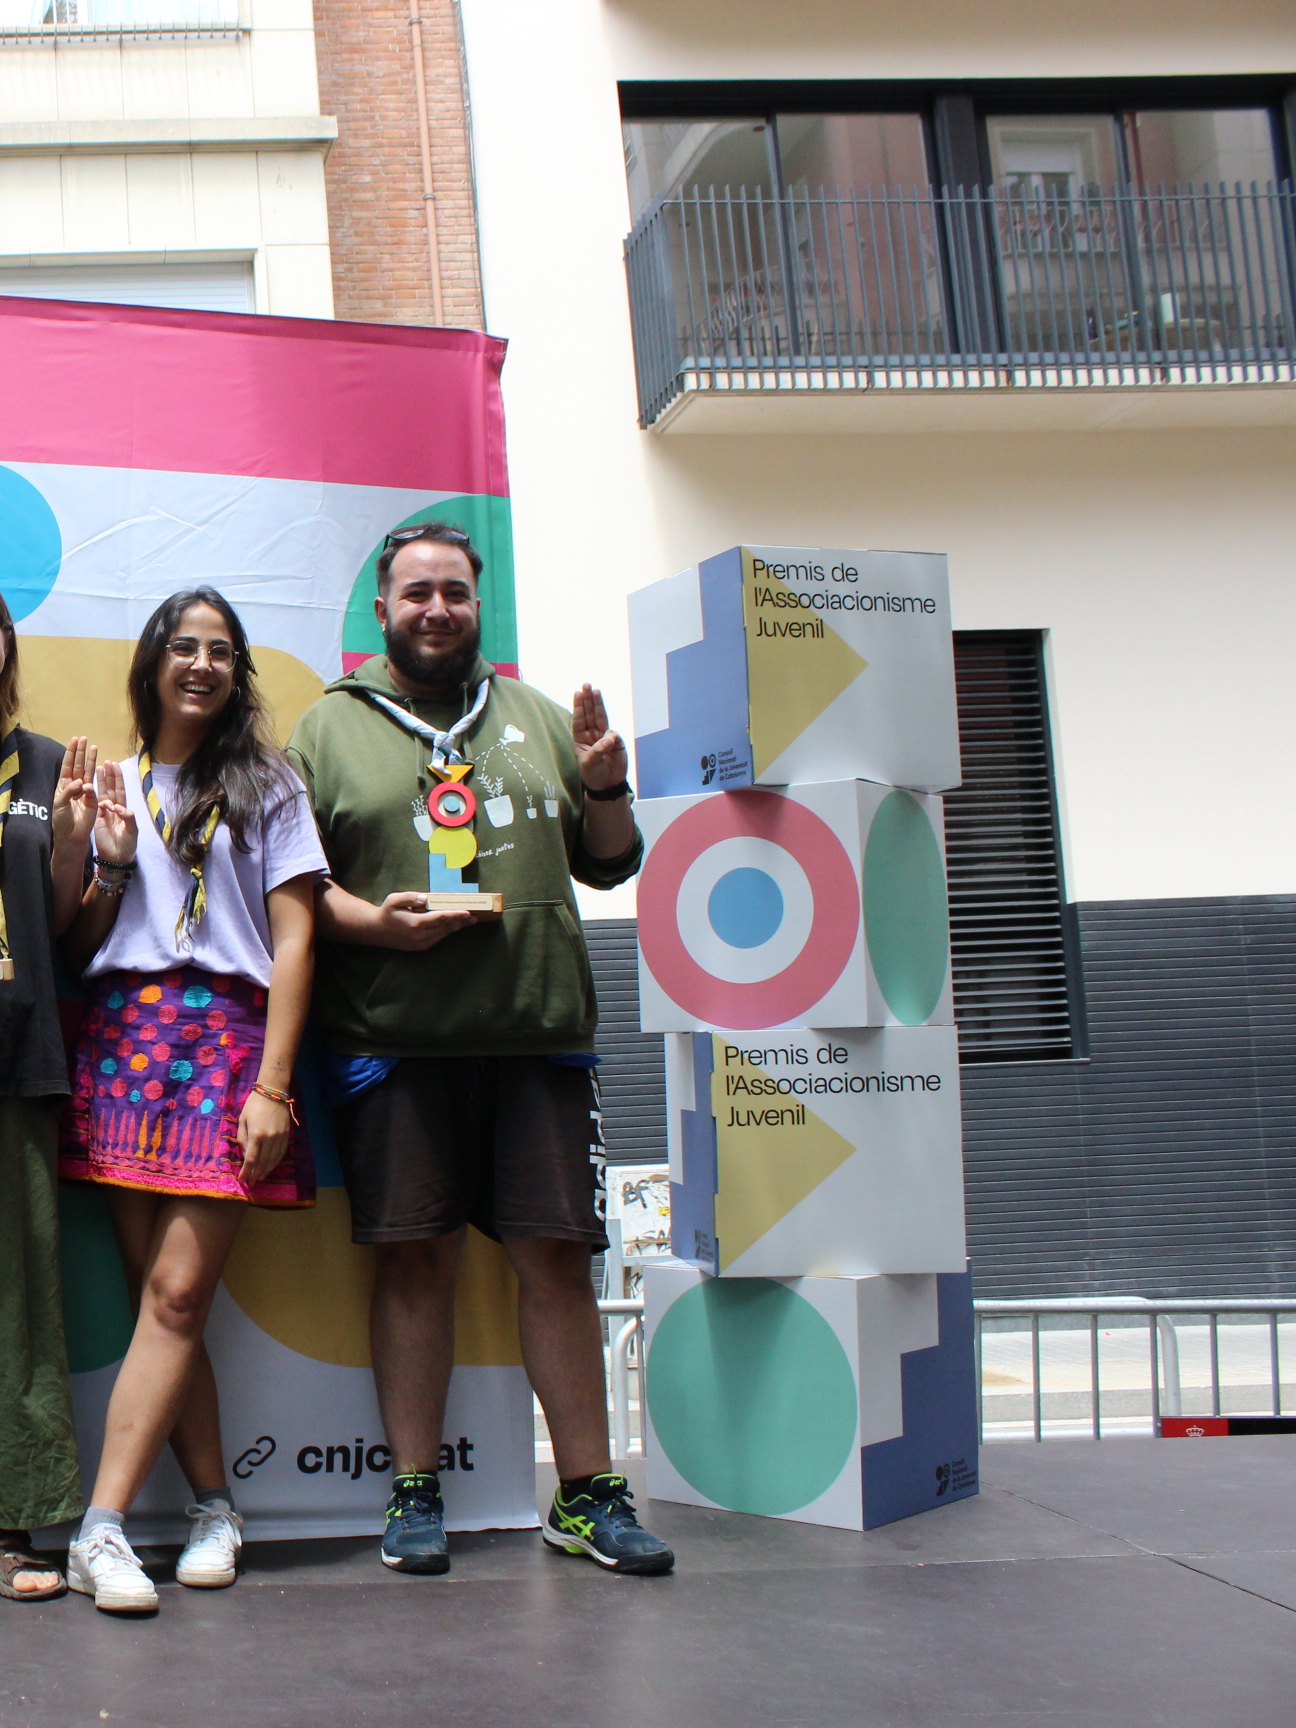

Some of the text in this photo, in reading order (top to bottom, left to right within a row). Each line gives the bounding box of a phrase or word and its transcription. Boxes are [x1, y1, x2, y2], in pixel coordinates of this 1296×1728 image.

[752, 559, 859, 583] Premis de
[754, 587, 936, 614] l'Associacionisme
[756, 617, 825, 639] Juvenil
[724, 1043, 848, 1066] Premis de
[726, 1072, 941, 1096] l'Associacionisme
[728, 1104, 806, 1127] Juvenil
[297, 1437, 474, 1480] cnjcat
